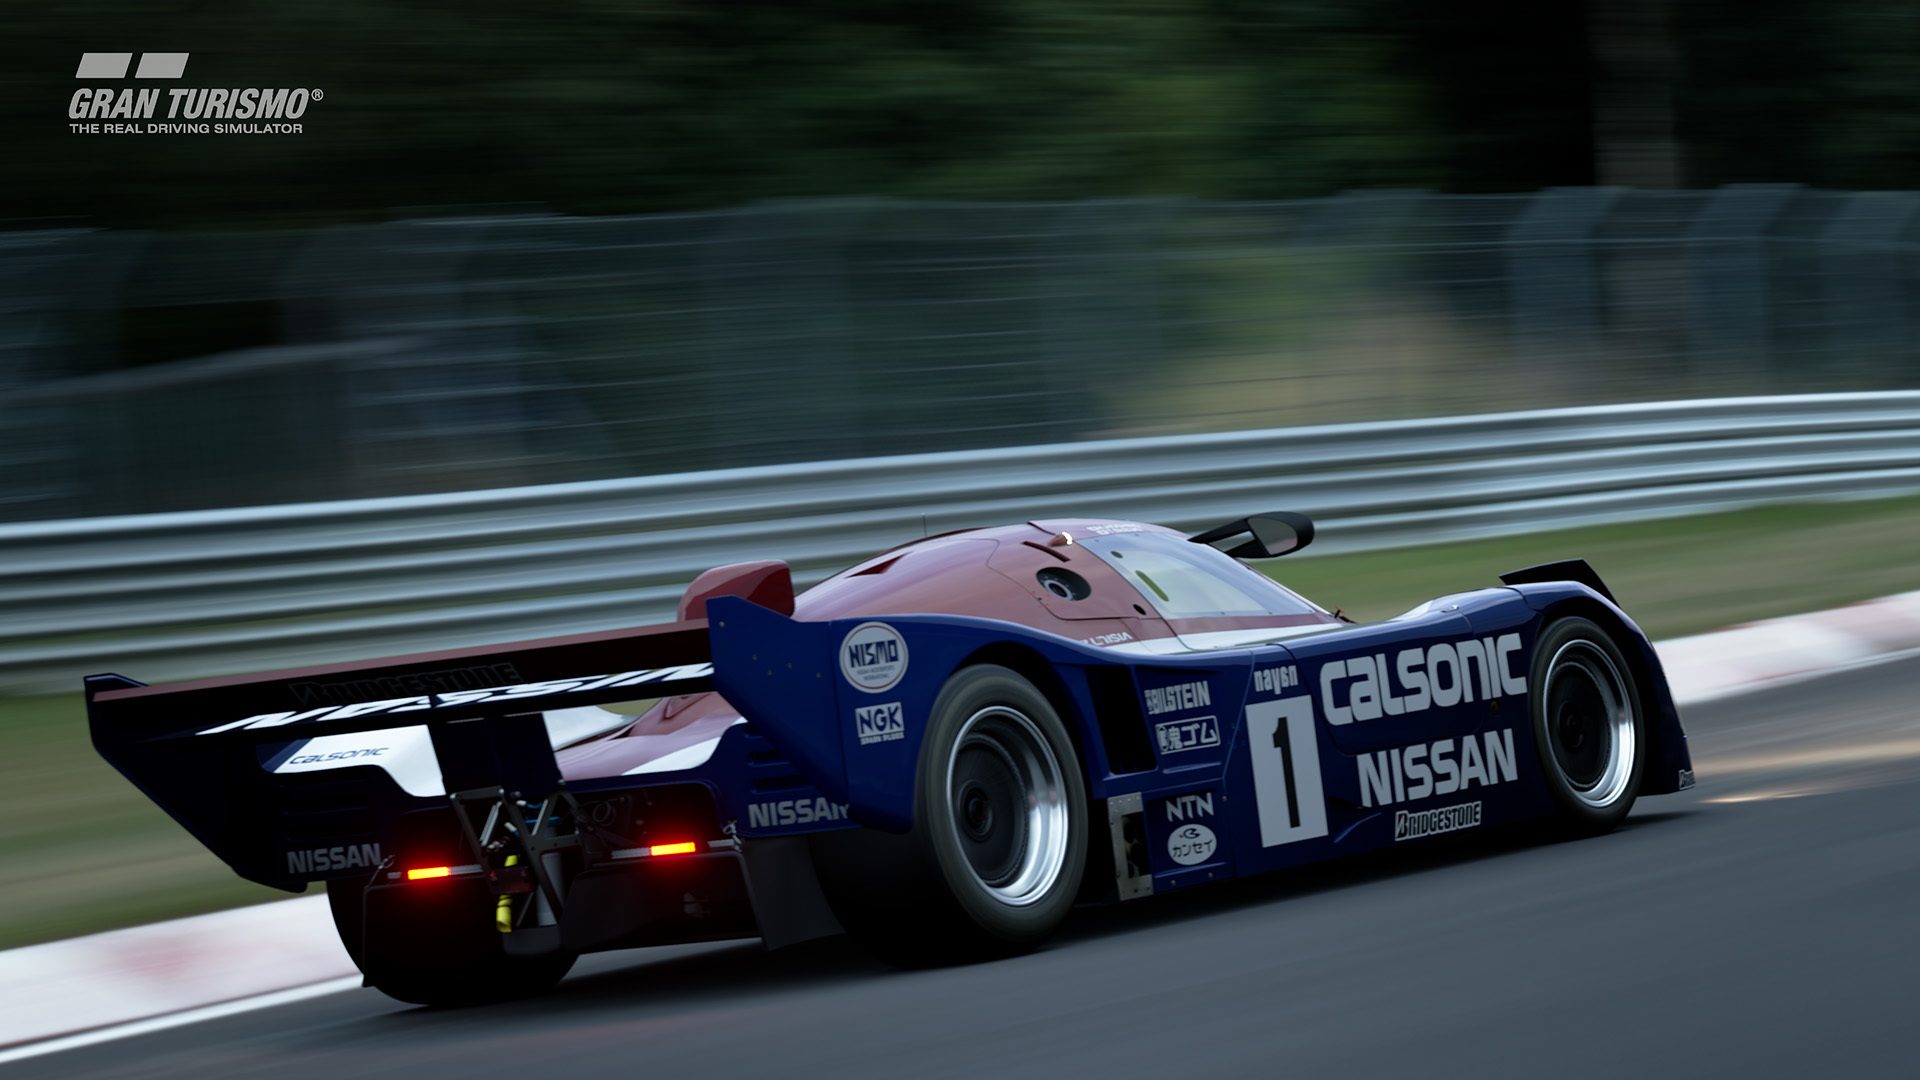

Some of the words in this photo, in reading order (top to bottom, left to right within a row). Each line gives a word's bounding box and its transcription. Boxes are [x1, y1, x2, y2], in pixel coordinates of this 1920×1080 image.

[848, 639, 900, 669] NISMO
[859, 704, 902, 734] NGK
[1272, 716, 1301, 829] 1
[1356, 727, 1519, 808] NISSAN
[1165, 791, 1215, 823] NTN
[1396, 801, 1482, 839] BRIDGESTONE
[286, 842, 382, 875] NISSAN
